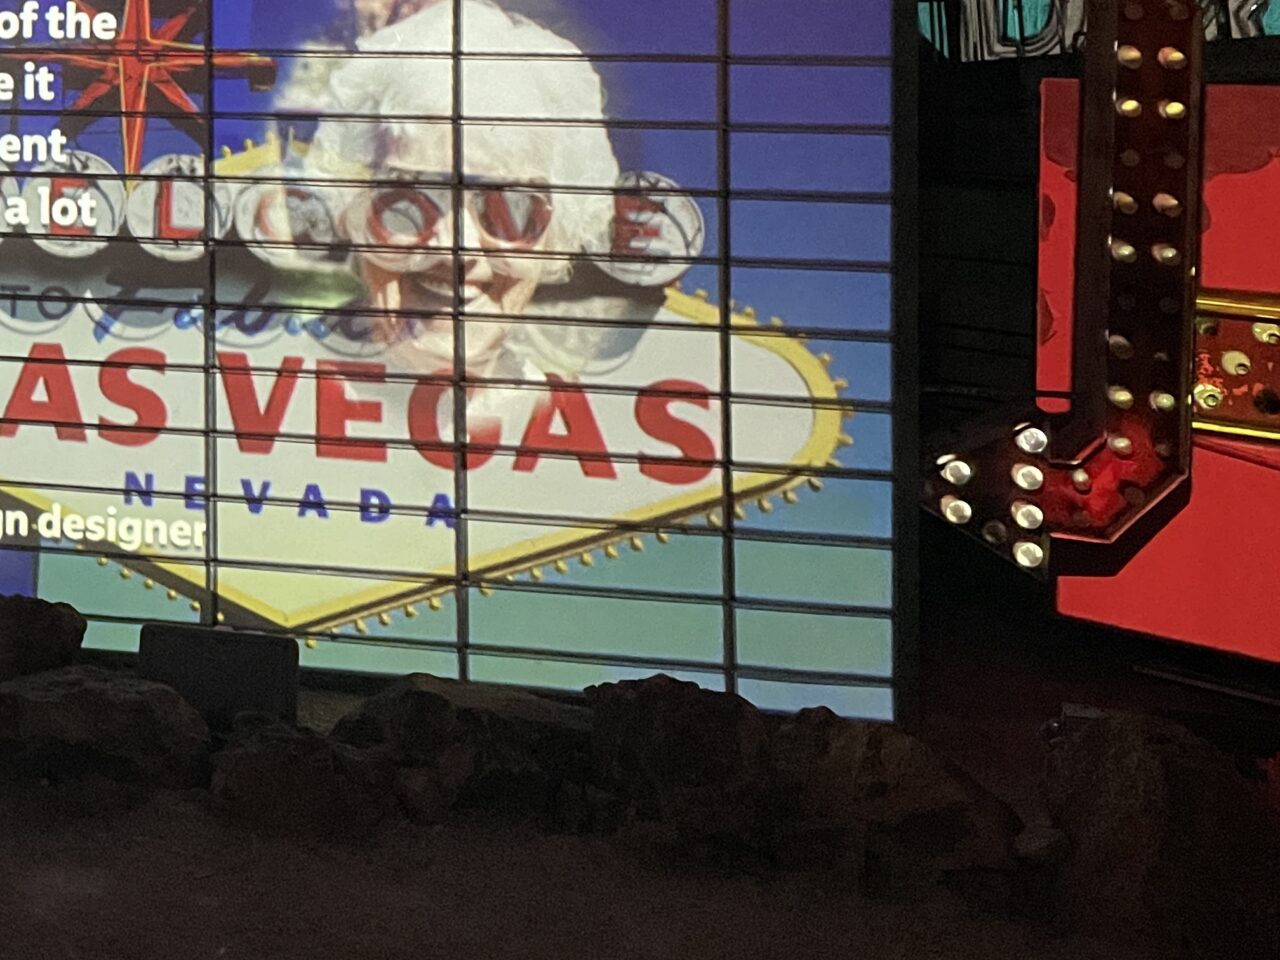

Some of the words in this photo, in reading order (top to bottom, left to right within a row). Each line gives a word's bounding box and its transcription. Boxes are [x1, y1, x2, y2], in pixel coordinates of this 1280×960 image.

[45, 1, 117, 40] the
[24, 62, 54, 101] it
[4, 197, 28, 226] a
[40, 186, 96, 227] lot
[0, 280, 73, 320] TO
[218, 351, 718, 485] VEGAS
[123, 471, 457, 529] NEVADA
[39, 503, 206, 550] designer
